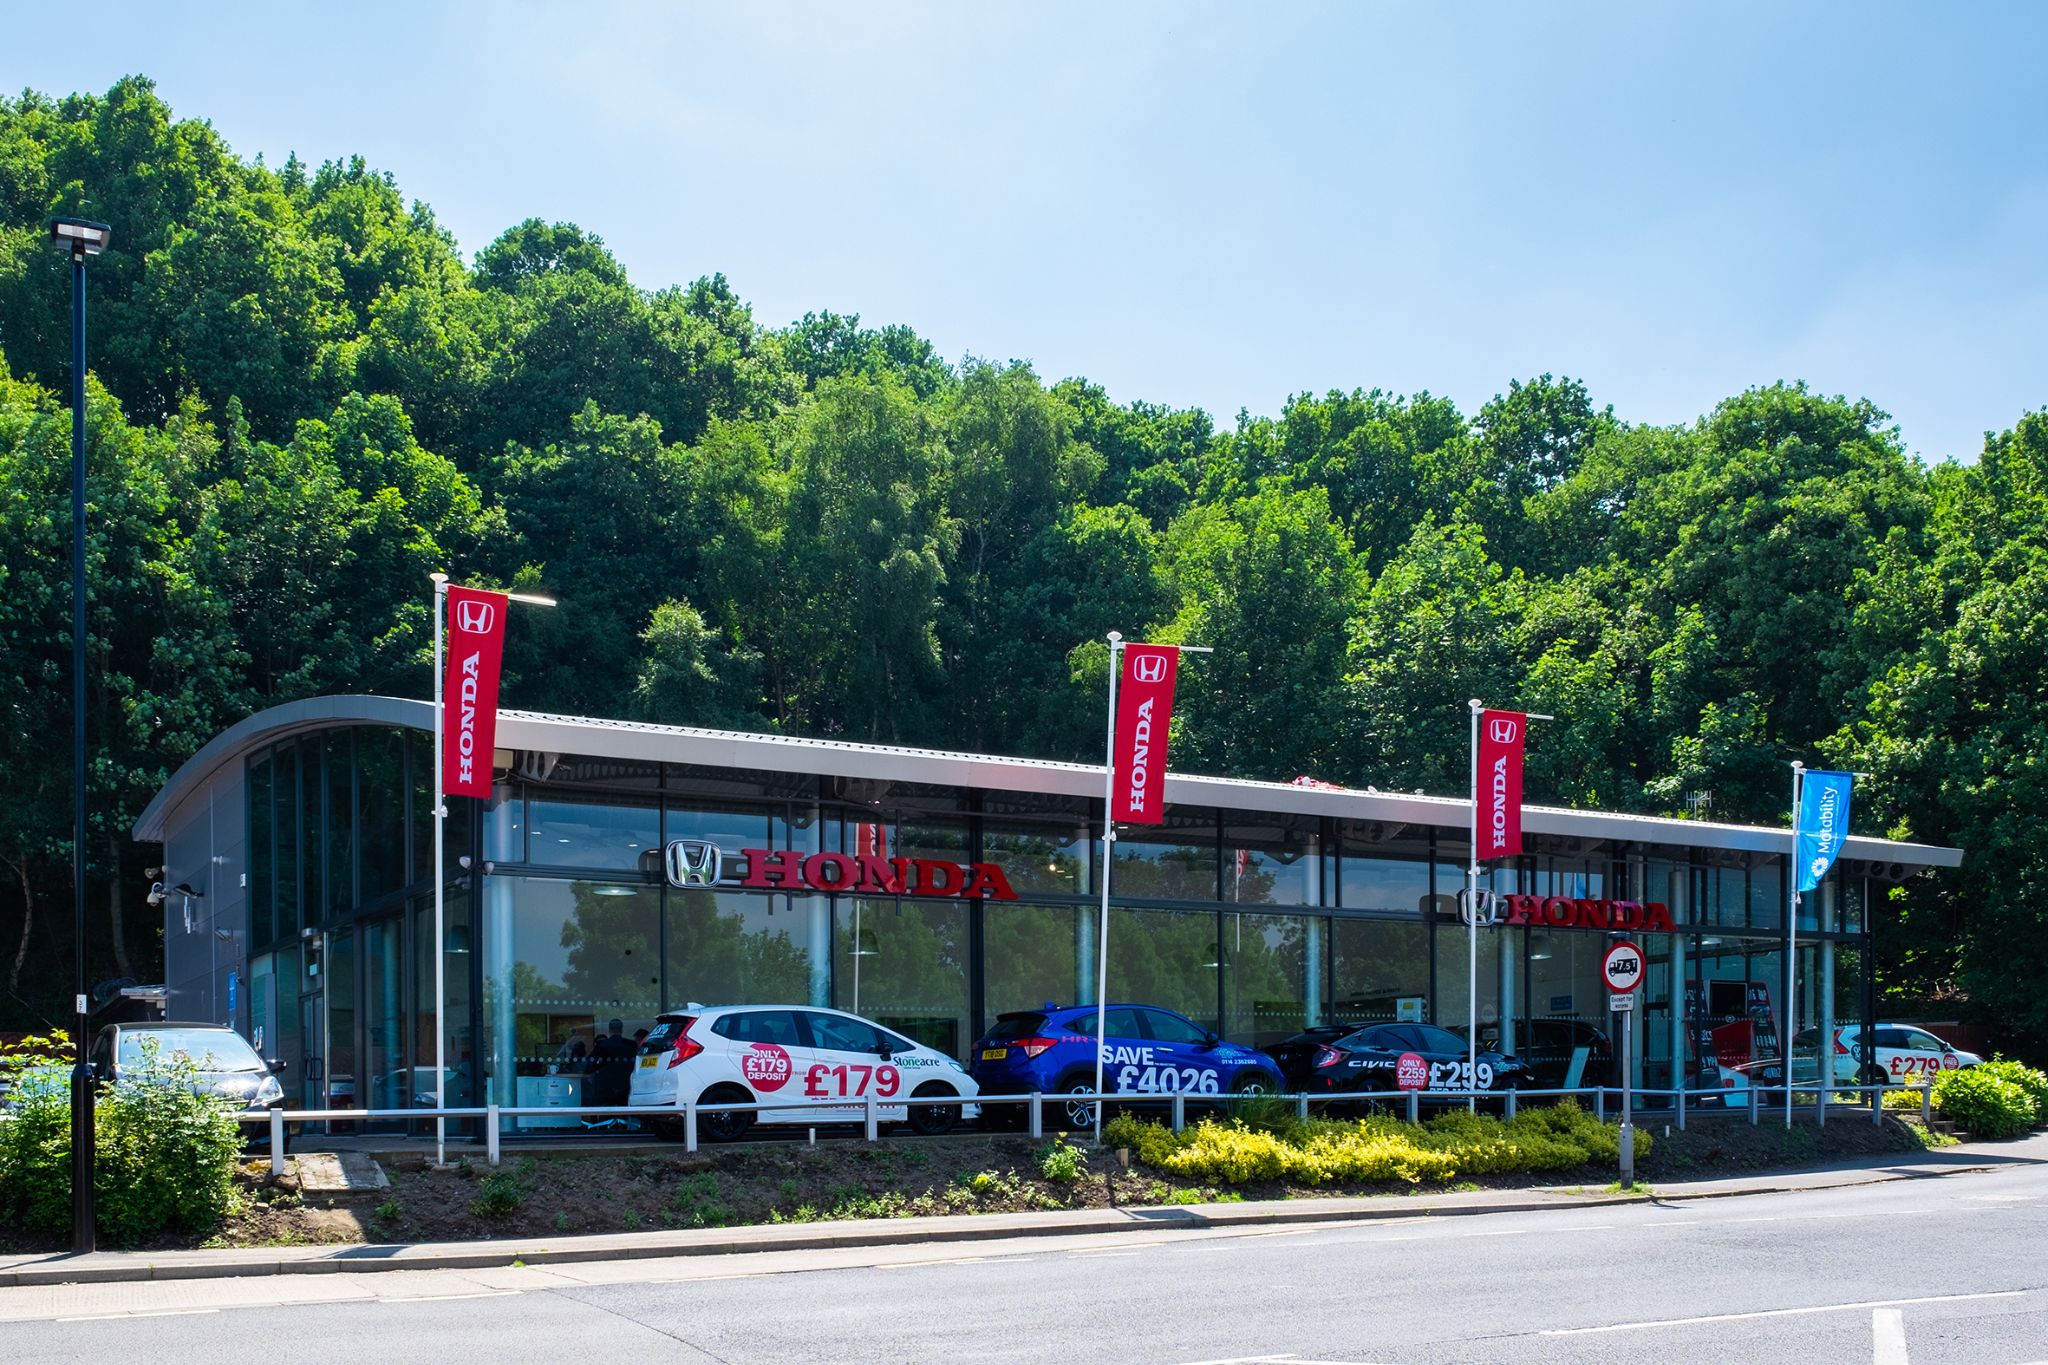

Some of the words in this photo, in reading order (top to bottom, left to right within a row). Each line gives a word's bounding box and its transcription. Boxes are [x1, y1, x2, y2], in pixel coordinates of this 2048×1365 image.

[459, 651, 480, 785] HONDA
[1130, 697, 1154, 813] HONDA
[1493, 755, 1507, 849] HONDA
[1818, 786, 1838, 853] Motability
[741, 848, 1019, 900] HONDA
[1504, 894, 1678, 931] HONDA
[747, 1058, 788, 1073] £179
[753, 1049, 781, 1059] ONLY
[893, 1056, 940, 1067] Stoneacre
[1102, 1045, 1154, 1066] SAVE
[1348, 1060, 1396, 1069] CIVIC
[1402, 1059, 1421, 1067] ONLY
[1890, 1056, 1940, 1076] £279
[747, 1072, 787, 1081] DEPOSIT
[804, 1064, 900, 1097] £179
[1117, 1065, 1219, 1094] £4026
[1398, 1067, 1427, 1079] £259
[1428, 1061, 1494, 1089] £259
